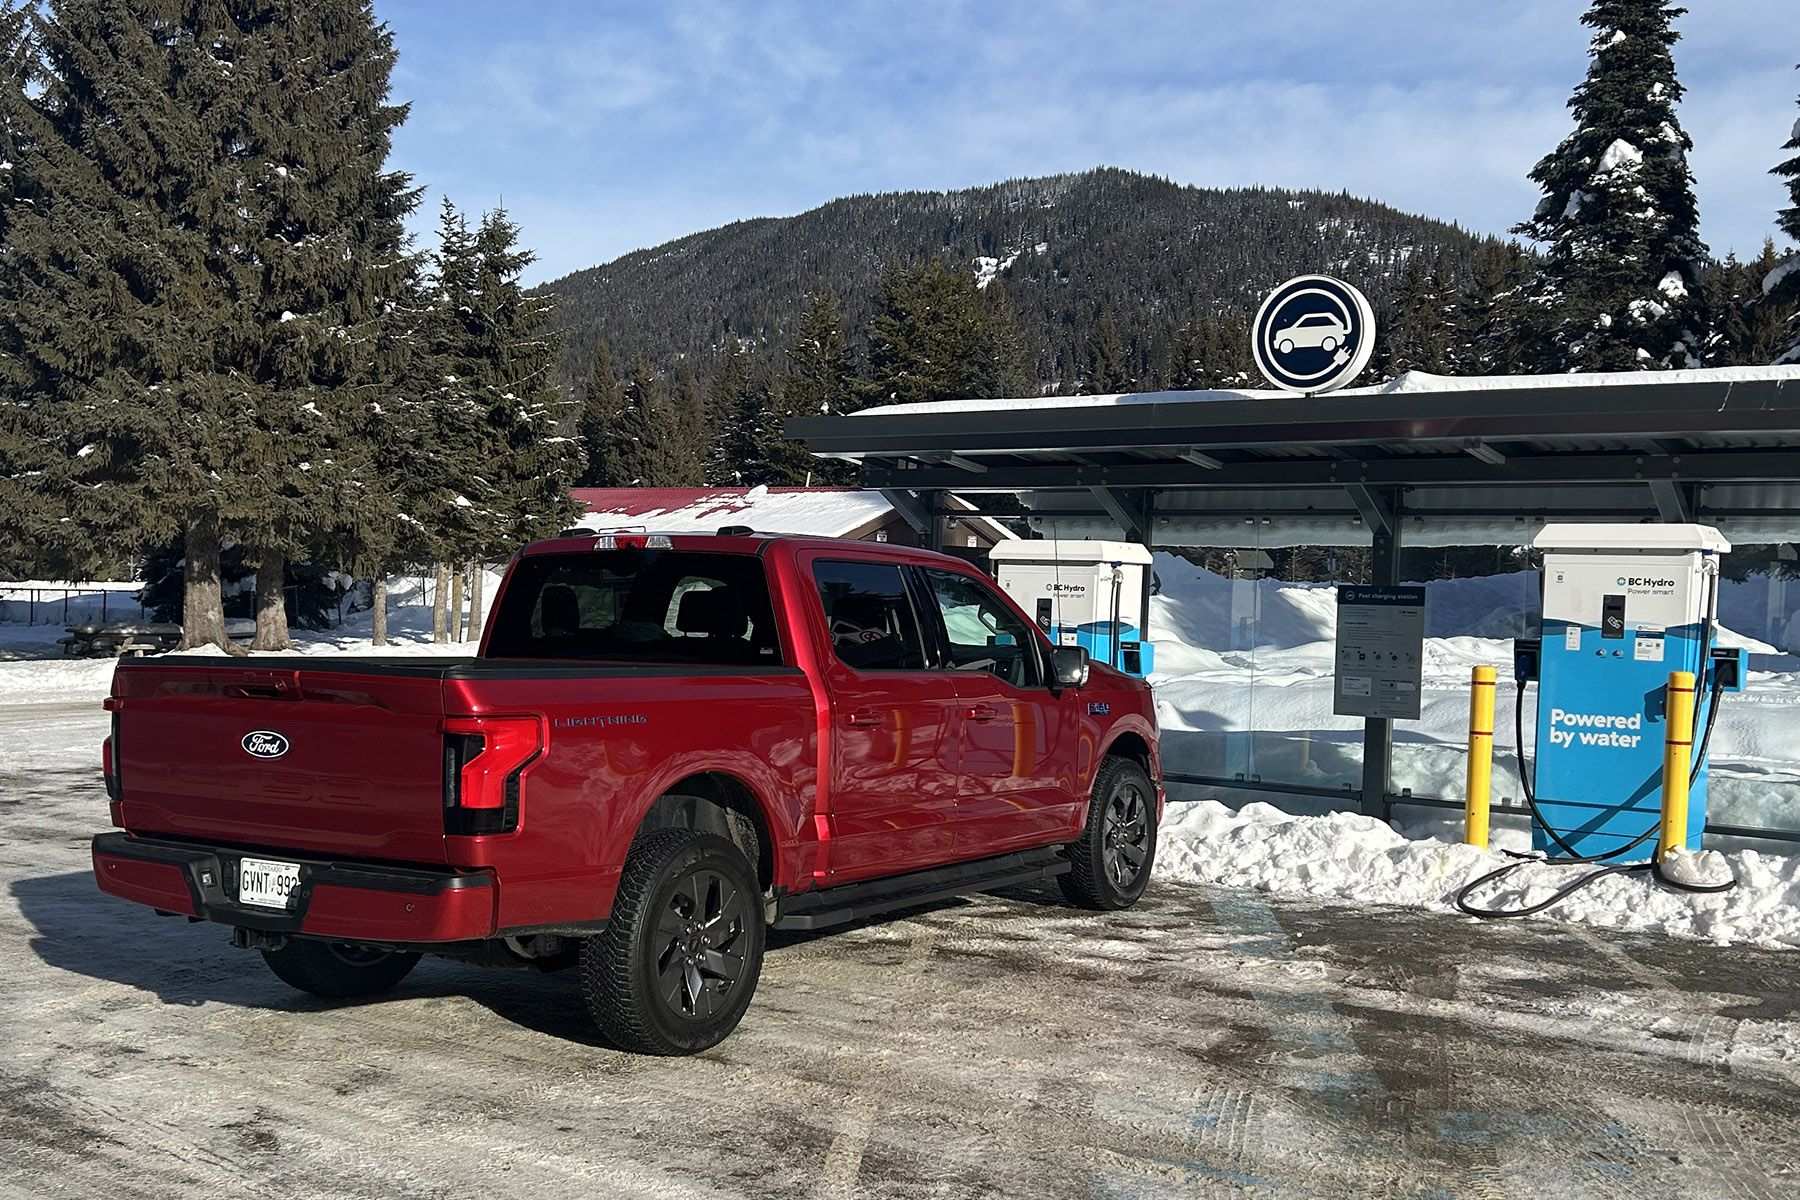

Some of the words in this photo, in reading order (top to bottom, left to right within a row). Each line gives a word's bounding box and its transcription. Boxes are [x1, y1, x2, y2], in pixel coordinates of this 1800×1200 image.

[1063, 584, 1085, 592] Hydro
[1628, 578, 1642, 586] BC
[1643, 578, 1675, 588] Hydro
[1371, 592, 1396, 600] charging
[554, 715, 648, 728] LIGHTNING
[1551, 708, 1641, 730] Powered
[249, 733, 280, 754] Ford
[1550, 726, 1575, 748] by
[1579, 731, 1641, 748] water
